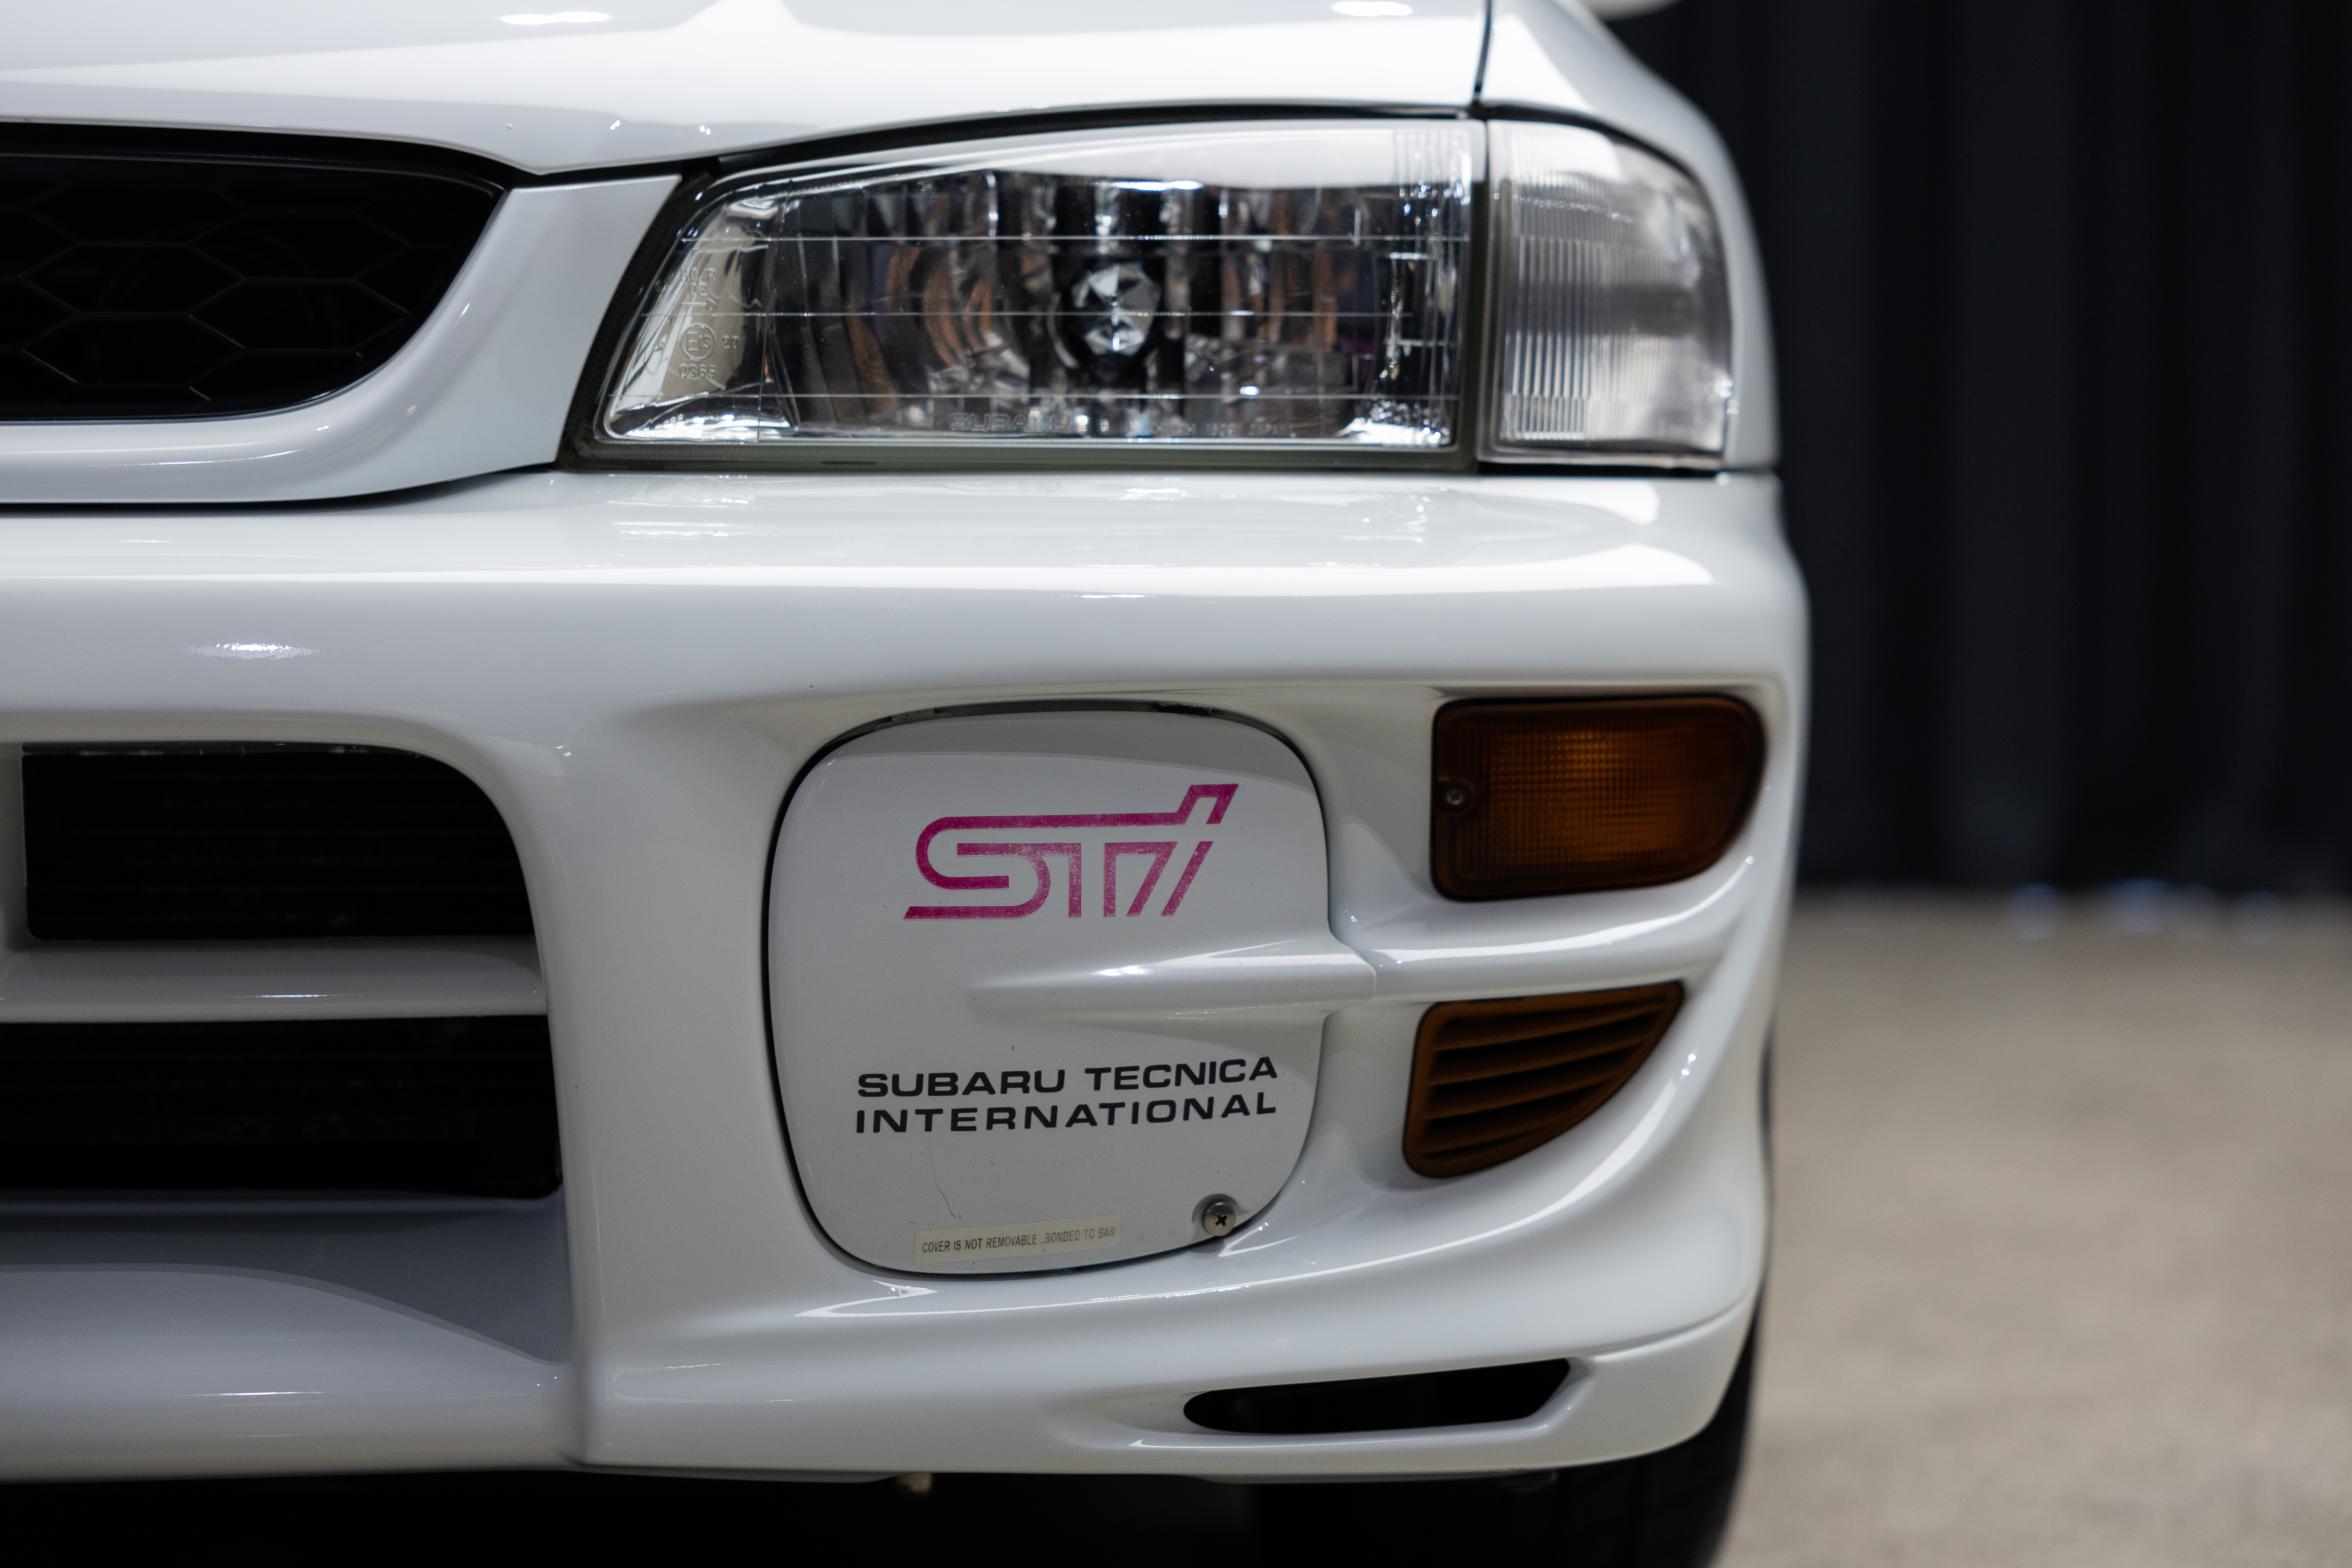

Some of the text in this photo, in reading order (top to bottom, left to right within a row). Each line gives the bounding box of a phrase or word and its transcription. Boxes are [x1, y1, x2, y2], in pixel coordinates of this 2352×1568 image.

[722, 334, 739, 349] 20
[857, 1056, 1278, 1098] SUBARU TECNICA
[856, 1092, 1276, 1133] INTERNATIONAL
[922, 1241, 950, 1253] COVER
[953, 1240, 961, 1251] IS
[965, 1238, 982, 1250] NOT
[986, 1234, 1038, 1249] REMOVABLE
[1084, 1228, 1095, 1240] TO
[1098, 1226, 1116, 1238] BAR
